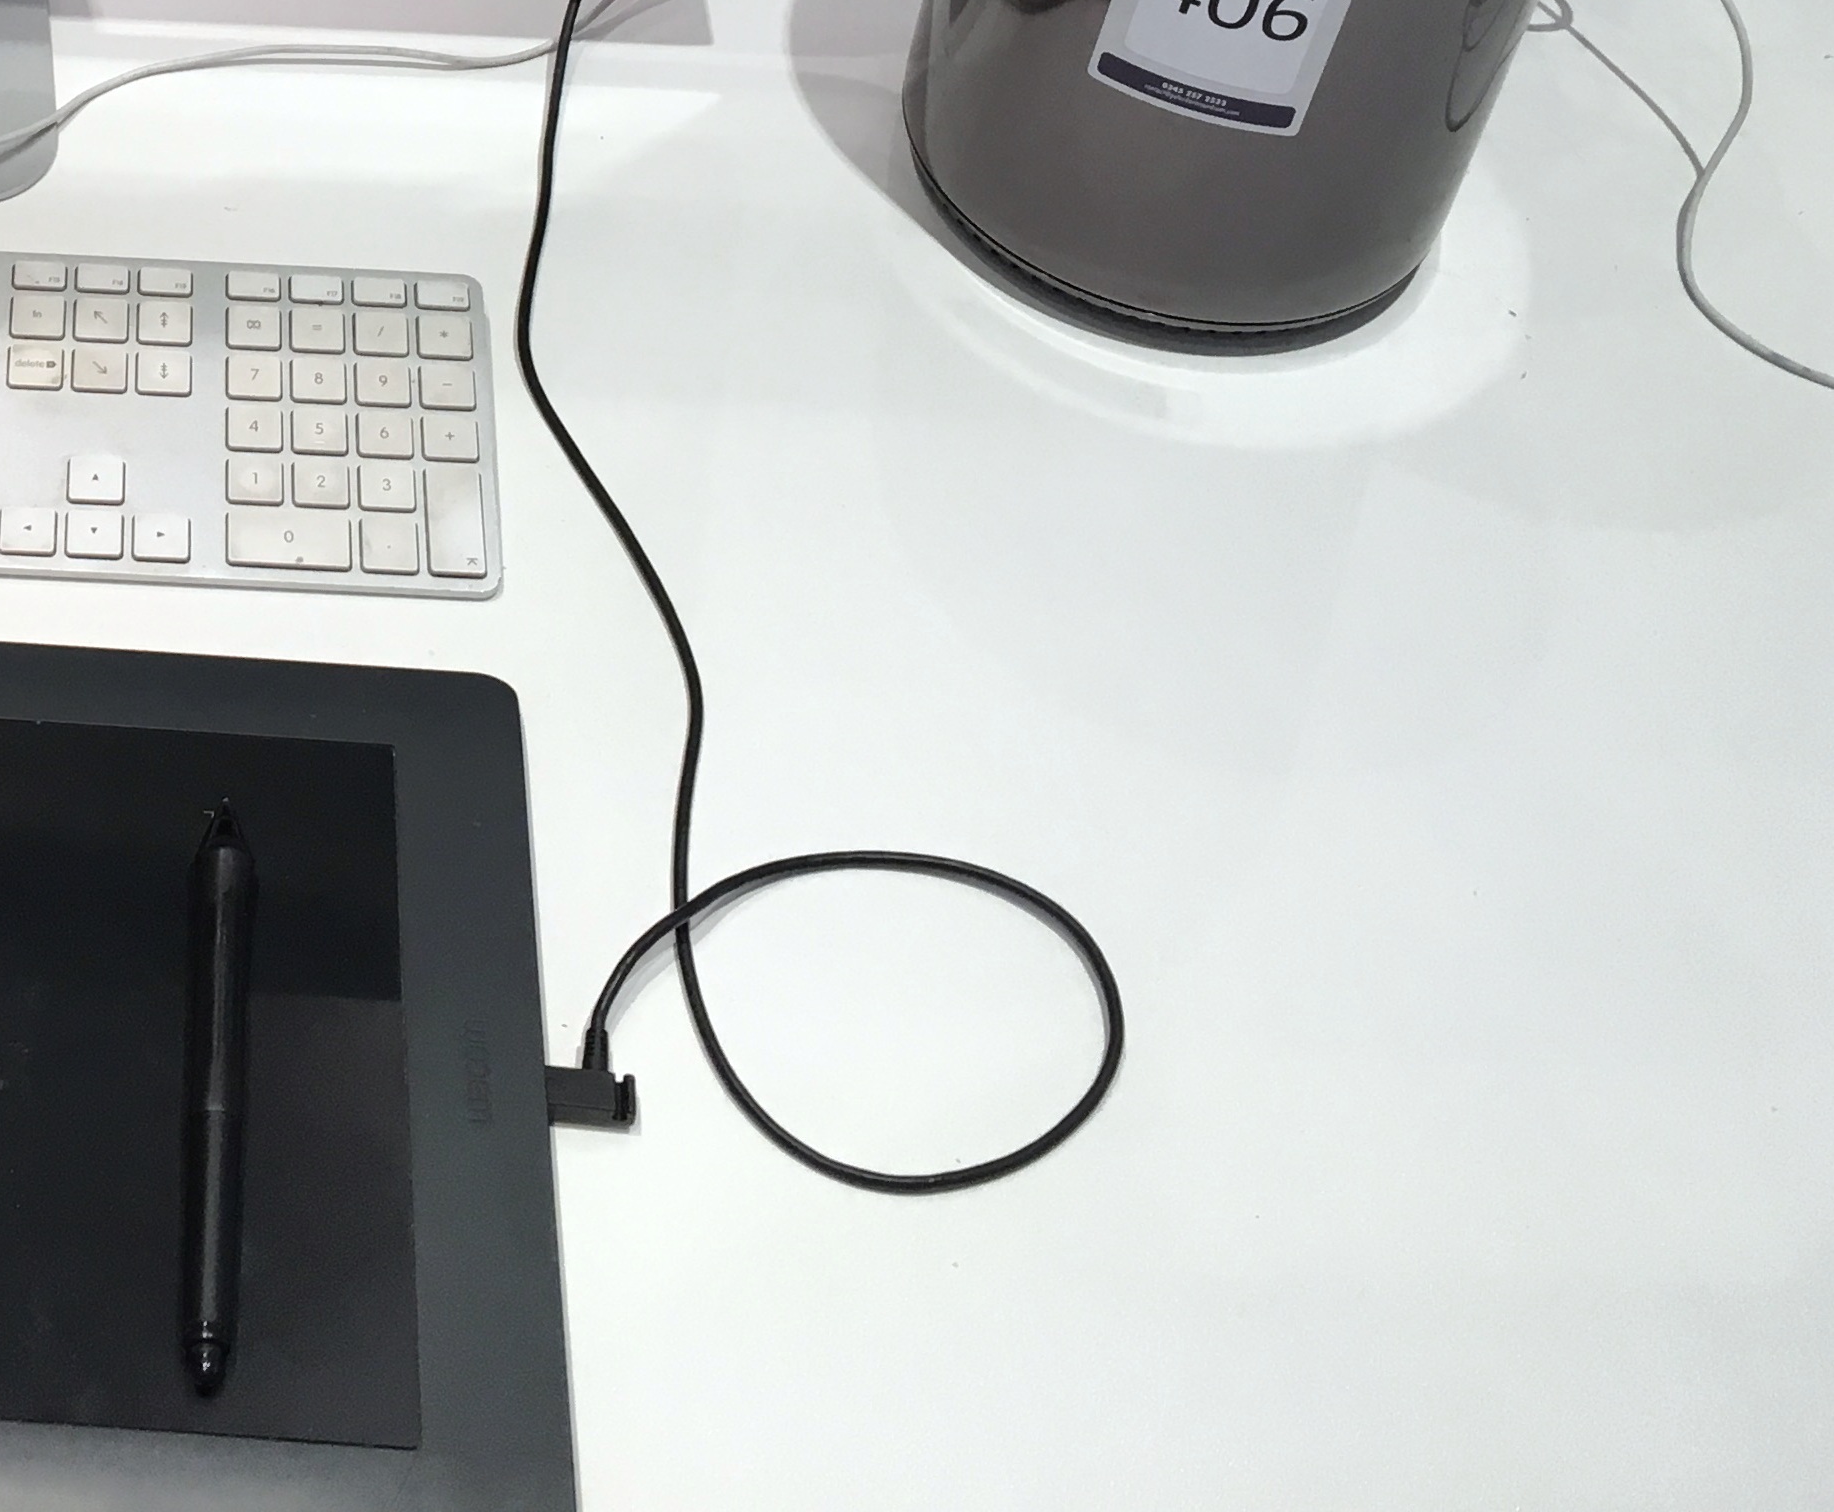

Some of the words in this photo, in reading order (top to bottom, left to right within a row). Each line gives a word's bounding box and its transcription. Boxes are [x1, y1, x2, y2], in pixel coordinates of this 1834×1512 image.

[251, 369, 259, 380] 7
[315, 373, 323, 384] 8
[379, 375, 387, 386] 9
[249, 420, 258, 432] 4
[315, 423, 323, 435] 5
[380, 427, 389, 439] 6
[251, 472, 258, 484] 1
[317, 475, 325, 488] 2
[383, 479, 391, 491] 3
[284, 531, 294, 543] 0
